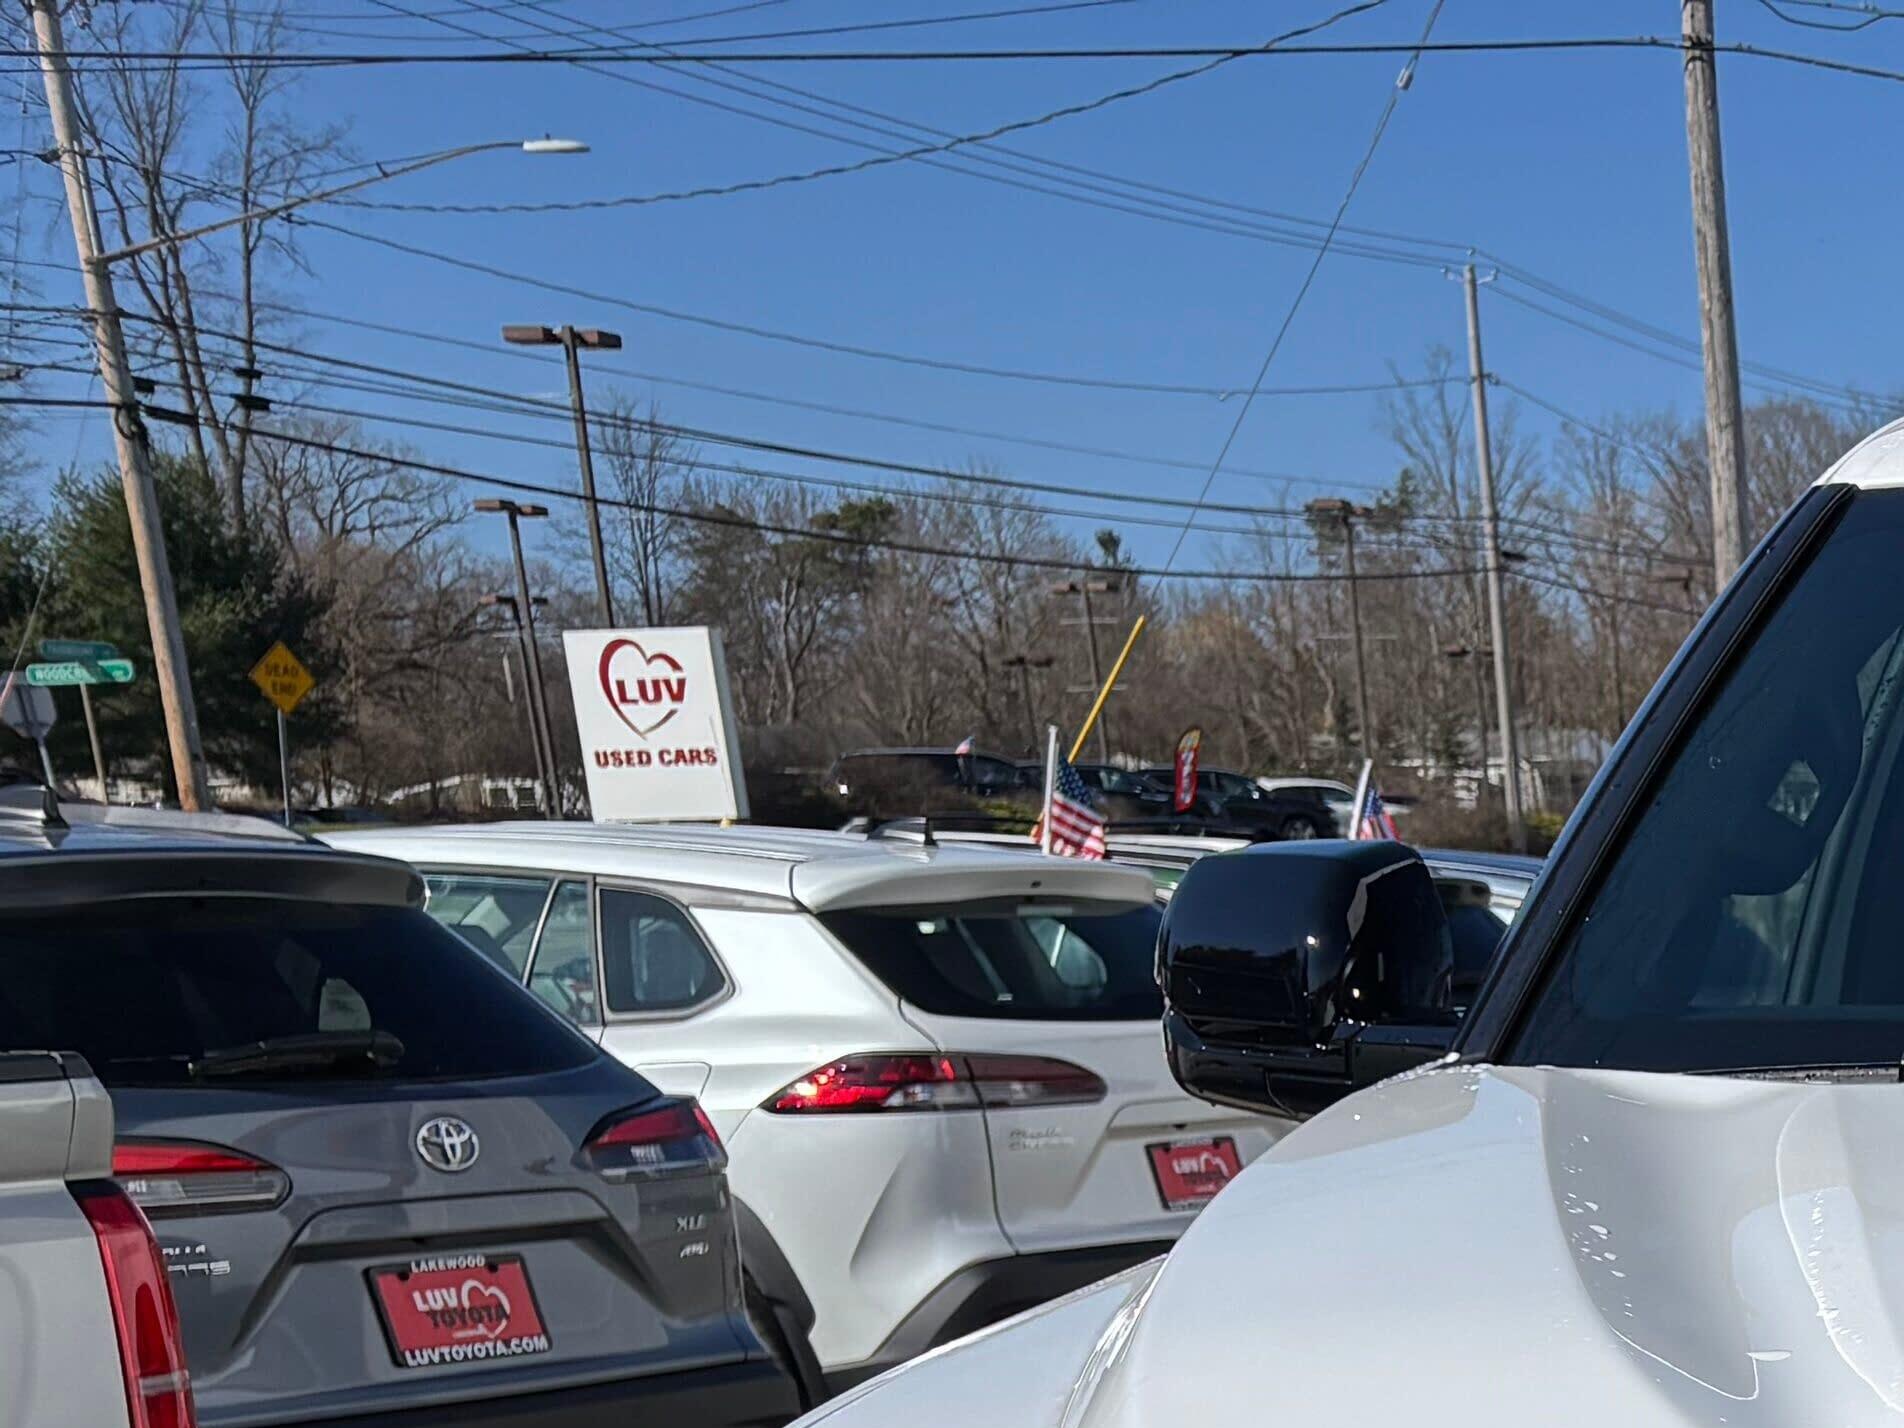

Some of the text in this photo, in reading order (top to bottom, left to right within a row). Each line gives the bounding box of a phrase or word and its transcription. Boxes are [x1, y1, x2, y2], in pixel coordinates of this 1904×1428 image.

[616, 678, 686, 704] LUV
[594, 747, 718, 768] USED CARS
[411, 1255, 486, 1273] LAKEWOOD
[413, 1287, 458, 1312] LUV
[427, 1304, 510, 1329] TOYOTA
[405, 1334, 549, 1367] LUVTOYOTA.COM
